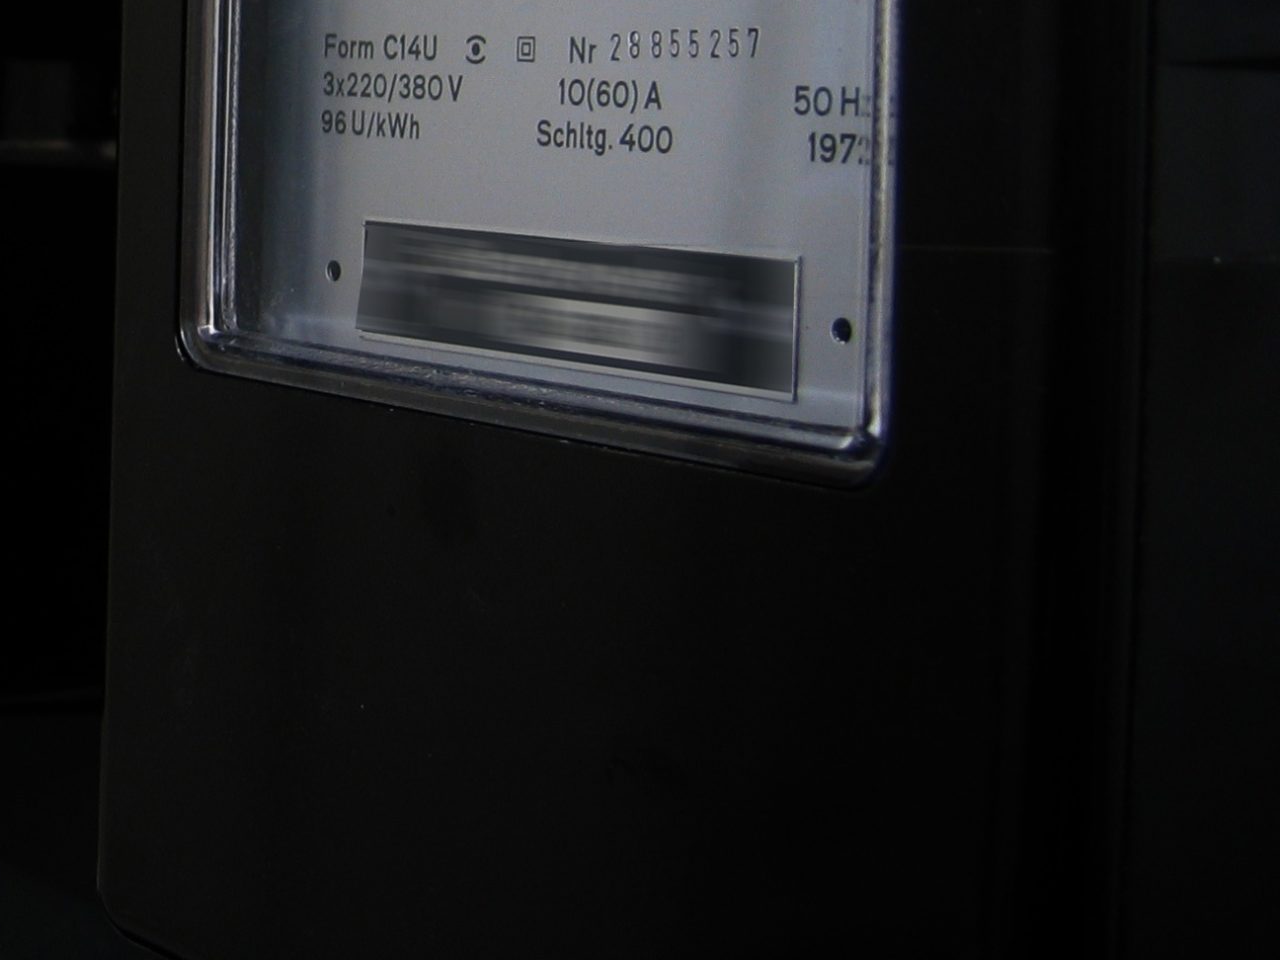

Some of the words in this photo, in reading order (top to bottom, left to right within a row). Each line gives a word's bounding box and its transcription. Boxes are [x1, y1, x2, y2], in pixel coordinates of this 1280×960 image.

[324, 33, 374, 59] Form
[383, 34, 437, 61] C14U
[570, 37, 597, 64] Nr
[610, 28, 759, 62] 28855257
[794, 86, 832, 117] 50
[840, 86, 870, 117] H
[537, 120, 613, 156] Schltg.
[619, 124, 674, 154] 400
